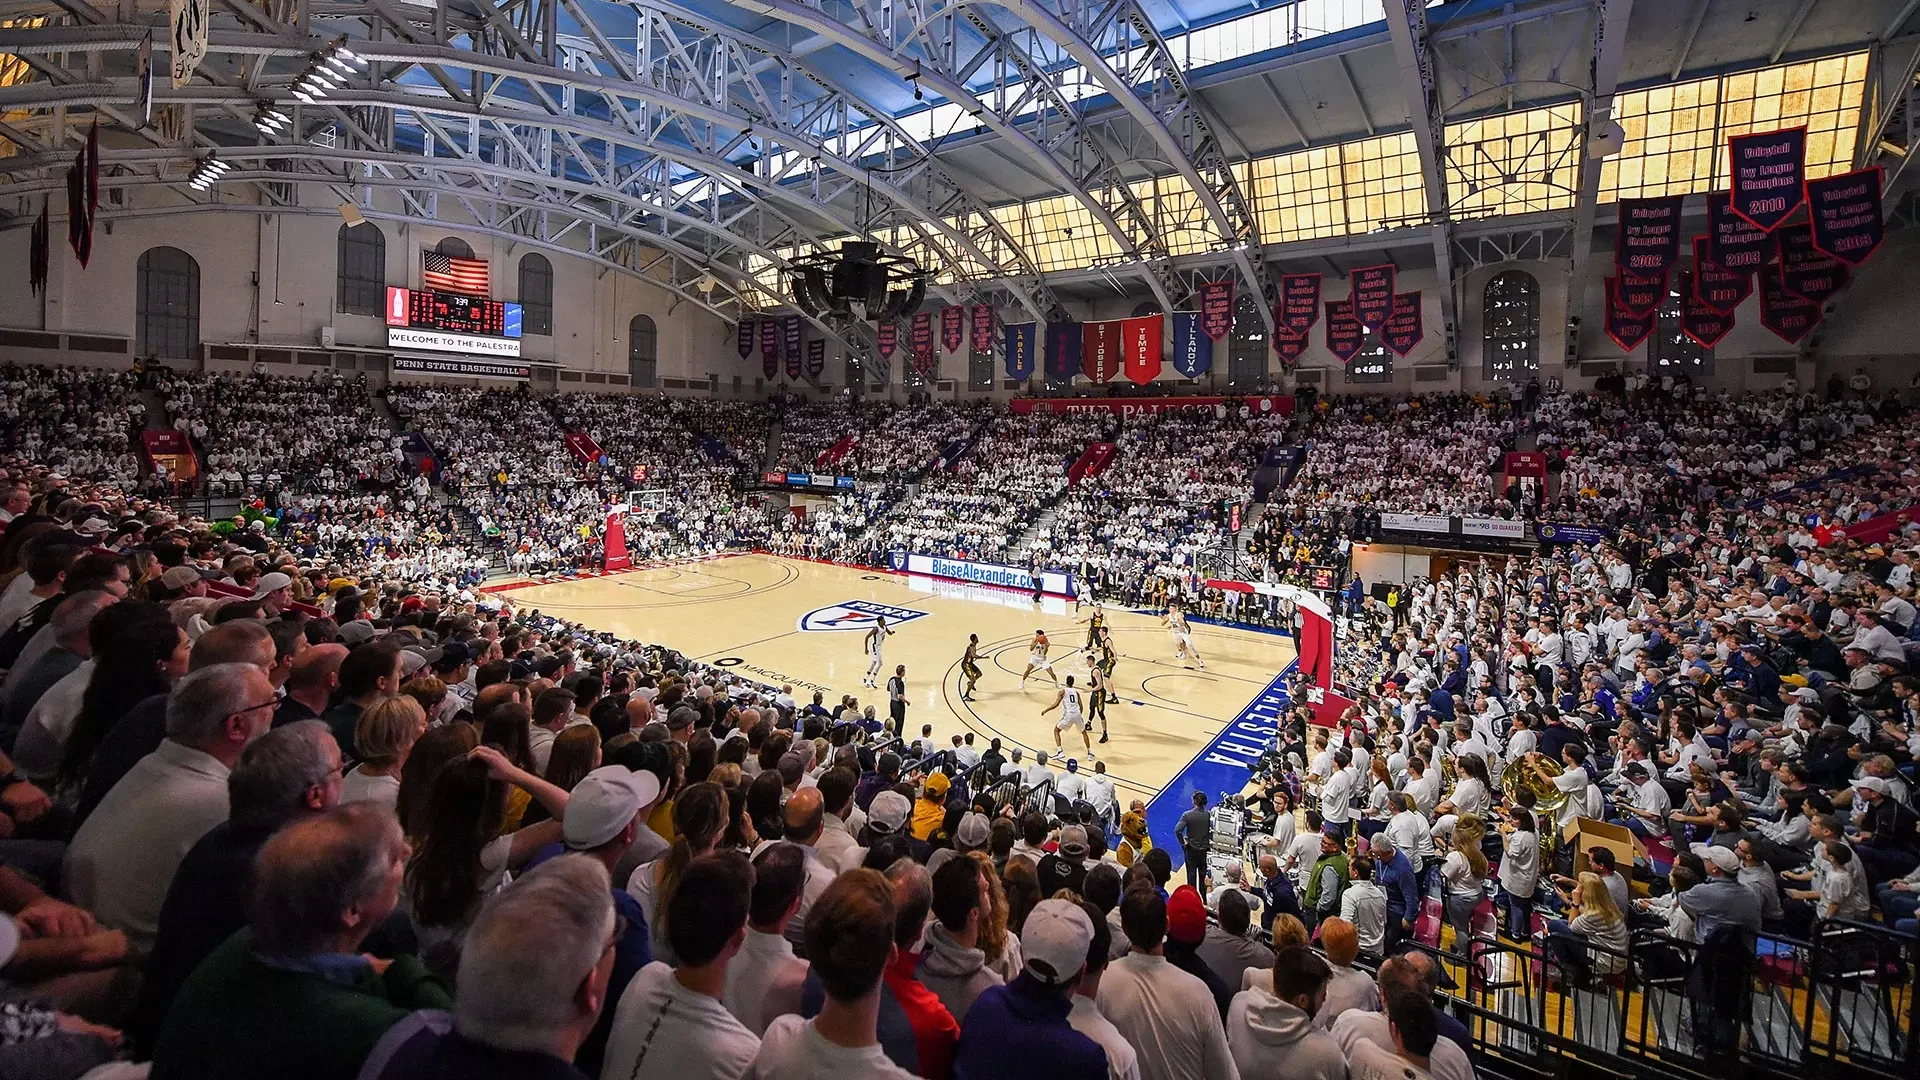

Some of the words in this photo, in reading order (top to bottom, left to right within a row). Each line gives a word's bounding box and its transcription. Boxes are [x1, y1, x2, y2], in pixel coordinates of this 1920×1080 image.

[1744, 143, 1790, 159] Volleyball
[1741, 167, 1756, 178] Ivy
[1759, 162, 1794, 175] League
[1741, 175, 1794, 191] Champions
[1822, 183, 1867, 202] Volleyball
[1632, 207, 1671, 219] Volleyball
[1749, 197, 1786, 214] 2010
[1821, 208, 1838, 219] Ivy
[1840, 200, 1873, 214] League
[1627, 226, 1641, 236] Ivy
[1642, 224, 1671, 235] League
[1719, 223, 1733, 234] Ivy
[1825, 214, 1875, 231] Champions
[1627, 236, 1669, 247] Champions
[1720, 232, 1767, 244] Champions
[1630, 255, 1663, 268] 2002
[1725, 251, 1760, 267] 2003
[454, 297, 469, 306] 7:39
[390, 333, 439, 345] WELCOME
[442, 338, 454, 346] TO
[456, 339, 474, 348] THE
[476, 341, 520, 352] PALESTRA
[1137, 327, 1147, 367] TEMPLE
[1186, 314, 1198, 373] VILLANOVA
[395, 359, 424, 369] PENN
[426, 361, 458, 371] STATE
[460, 364, 520, 375] BASKETBALL
[932, 558, 1045, 588] BlaiseAlexander.co
[1315, 577, 1329, 586] 25
[846, 601, 917, 621] PENN
[1069, 694, 1075, 704] 0
